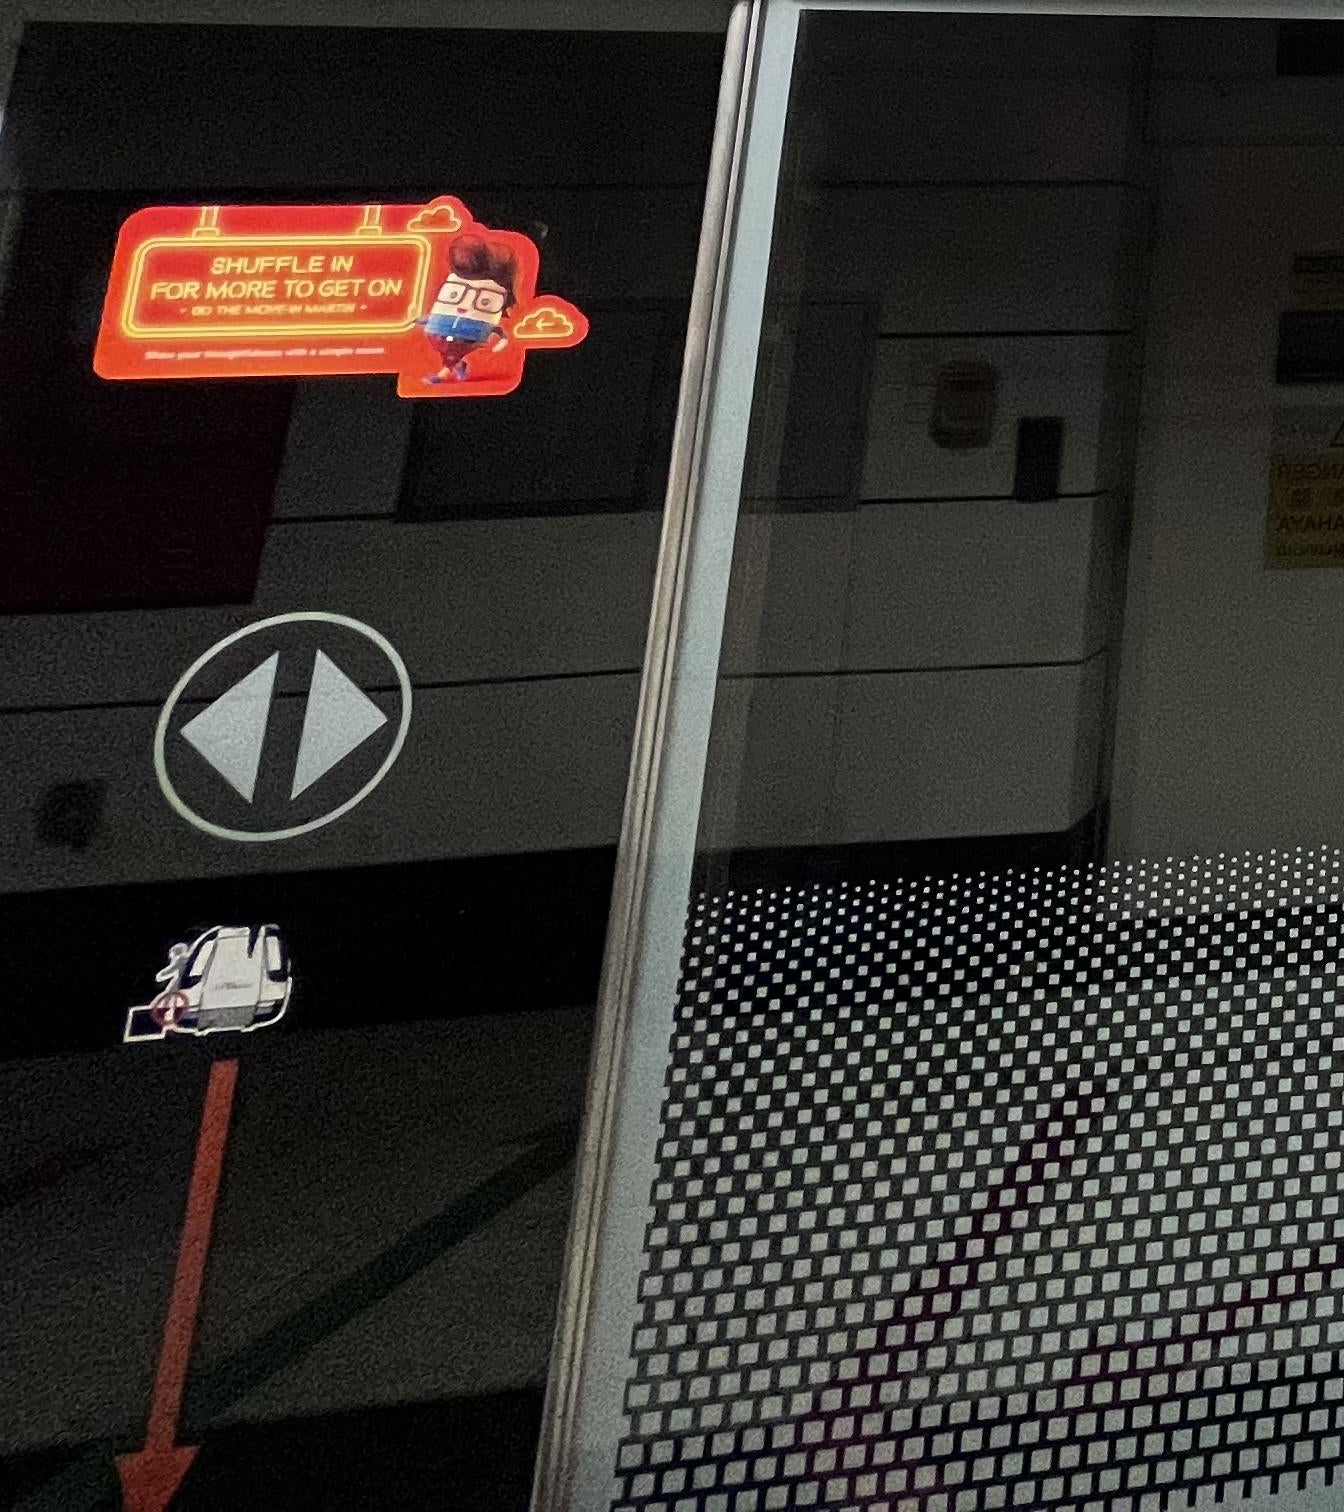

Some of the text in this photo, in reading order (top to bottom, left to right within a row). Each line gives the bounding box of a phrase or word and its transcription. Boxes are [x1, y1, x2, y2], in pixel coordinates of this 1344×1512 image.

[210, 255, 355, 275] SHUFFLE IN
[150, 278, 404, 300] FOR MORE TO GET ON
